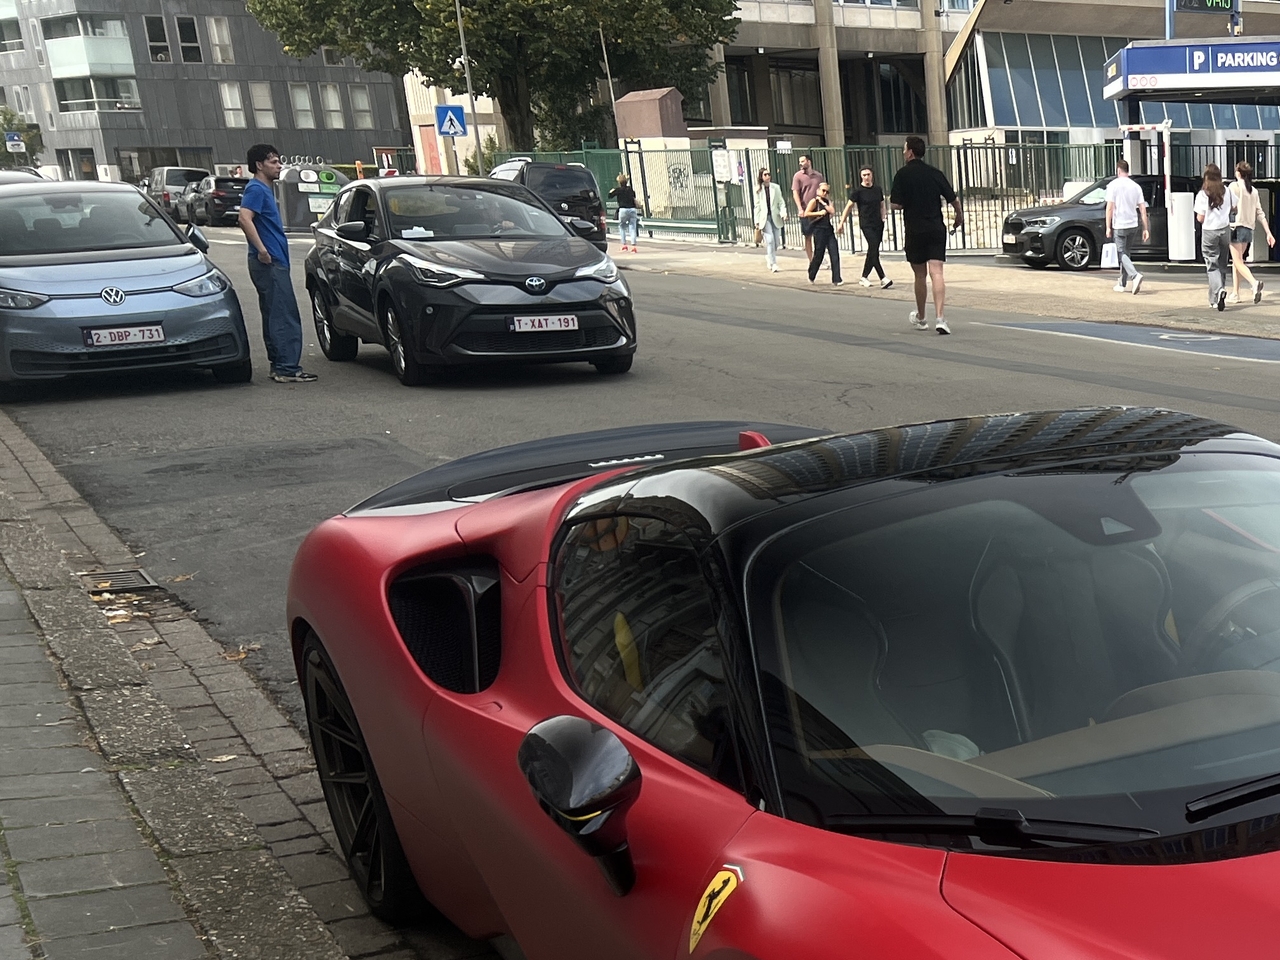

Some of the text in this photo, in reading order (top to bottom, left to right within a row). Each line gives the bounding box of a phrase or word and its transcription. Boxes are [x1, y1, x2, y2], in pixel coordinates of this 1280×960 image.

[1193, 50, 1205, 70] P
[1217, 52, 1278, 68] PARKING
[93, 328, 161, 344] 2-DBP-731
